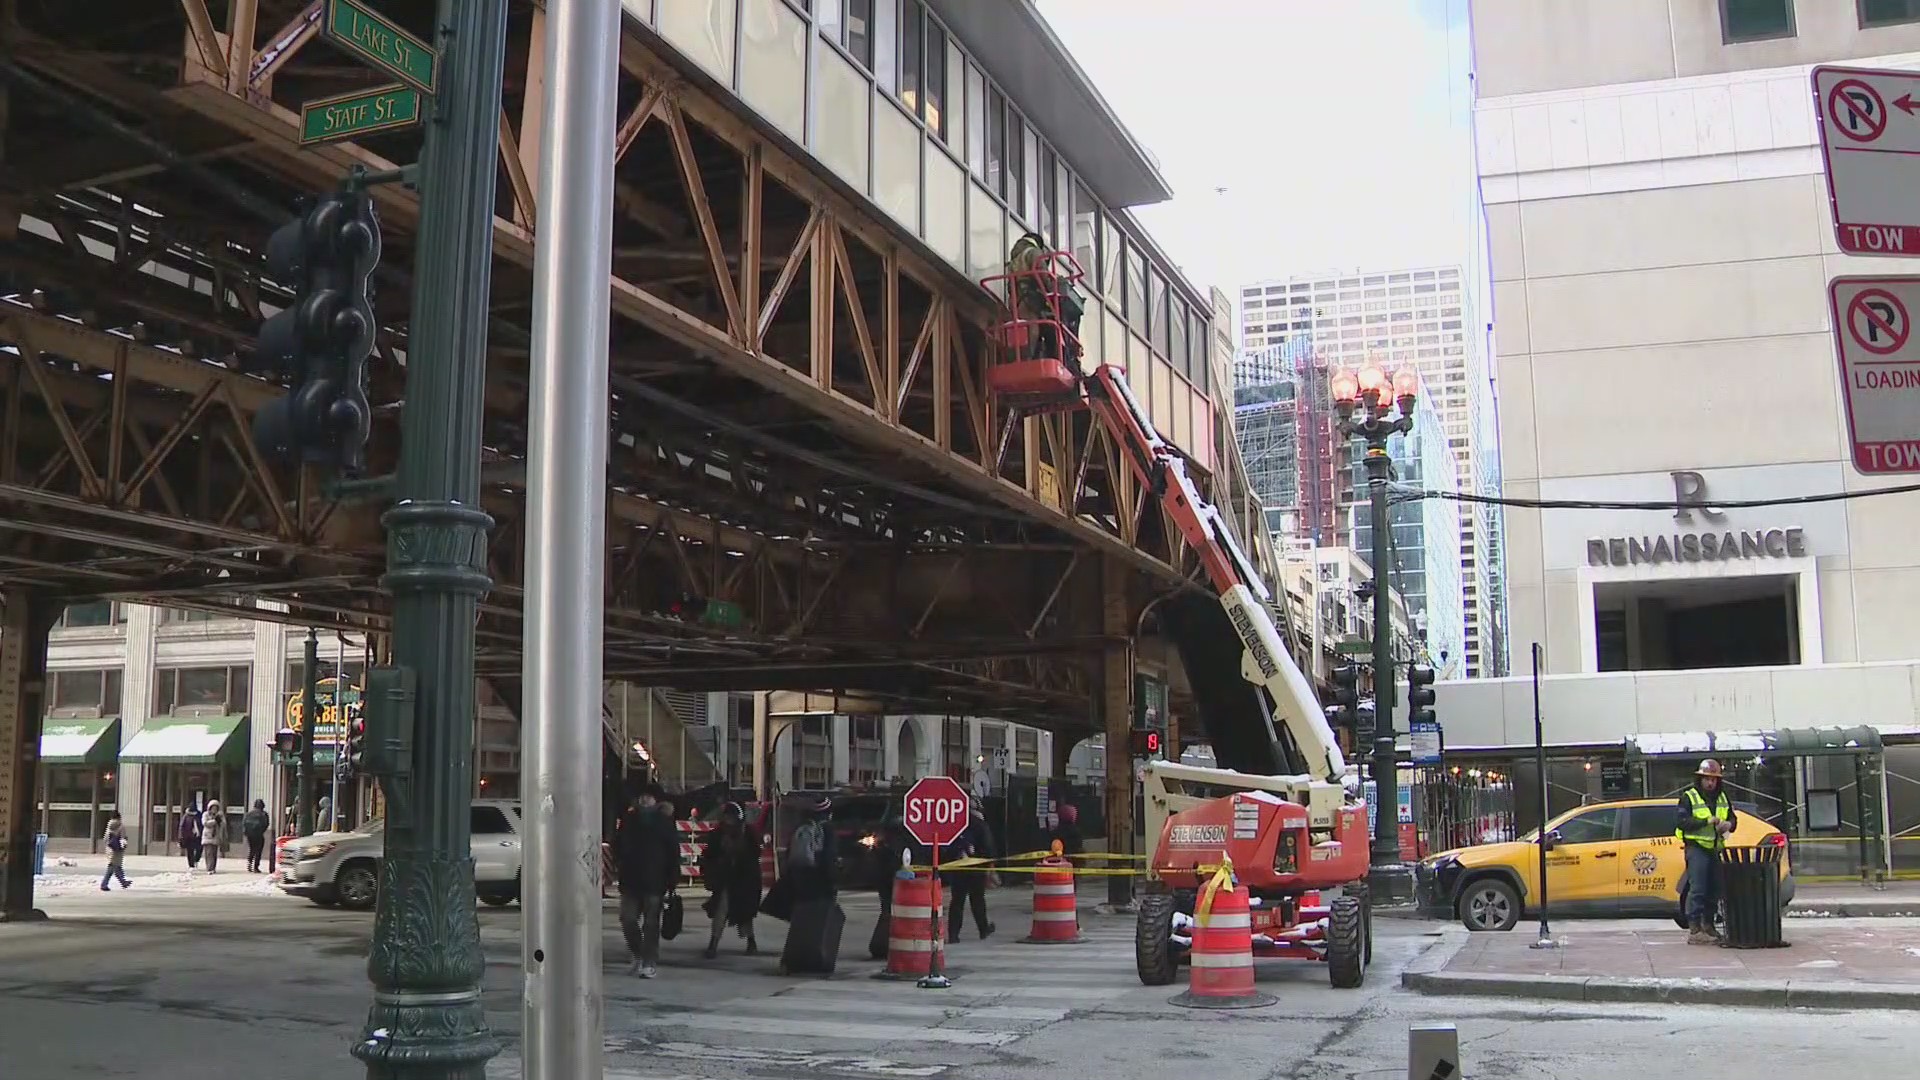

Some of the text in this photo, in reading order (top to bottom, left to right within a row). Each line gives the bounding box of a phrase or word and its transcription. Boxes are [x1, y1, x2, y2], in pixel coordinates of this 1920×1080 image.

[352, 12, 413, 71] LAKE ST.
[324, 96, 396, 131] STATE ST.
[1847, 225, 1904, 251] TOW
[1671, 471, 1725, 519] R
[1586, 525, 1805, 567] RENAISSANCE
[1228, 603, 1279, 679] STEVENSON
[908, 797, 964, 824] STOP
[1170, 825, 1228, 843] STEVENSON
